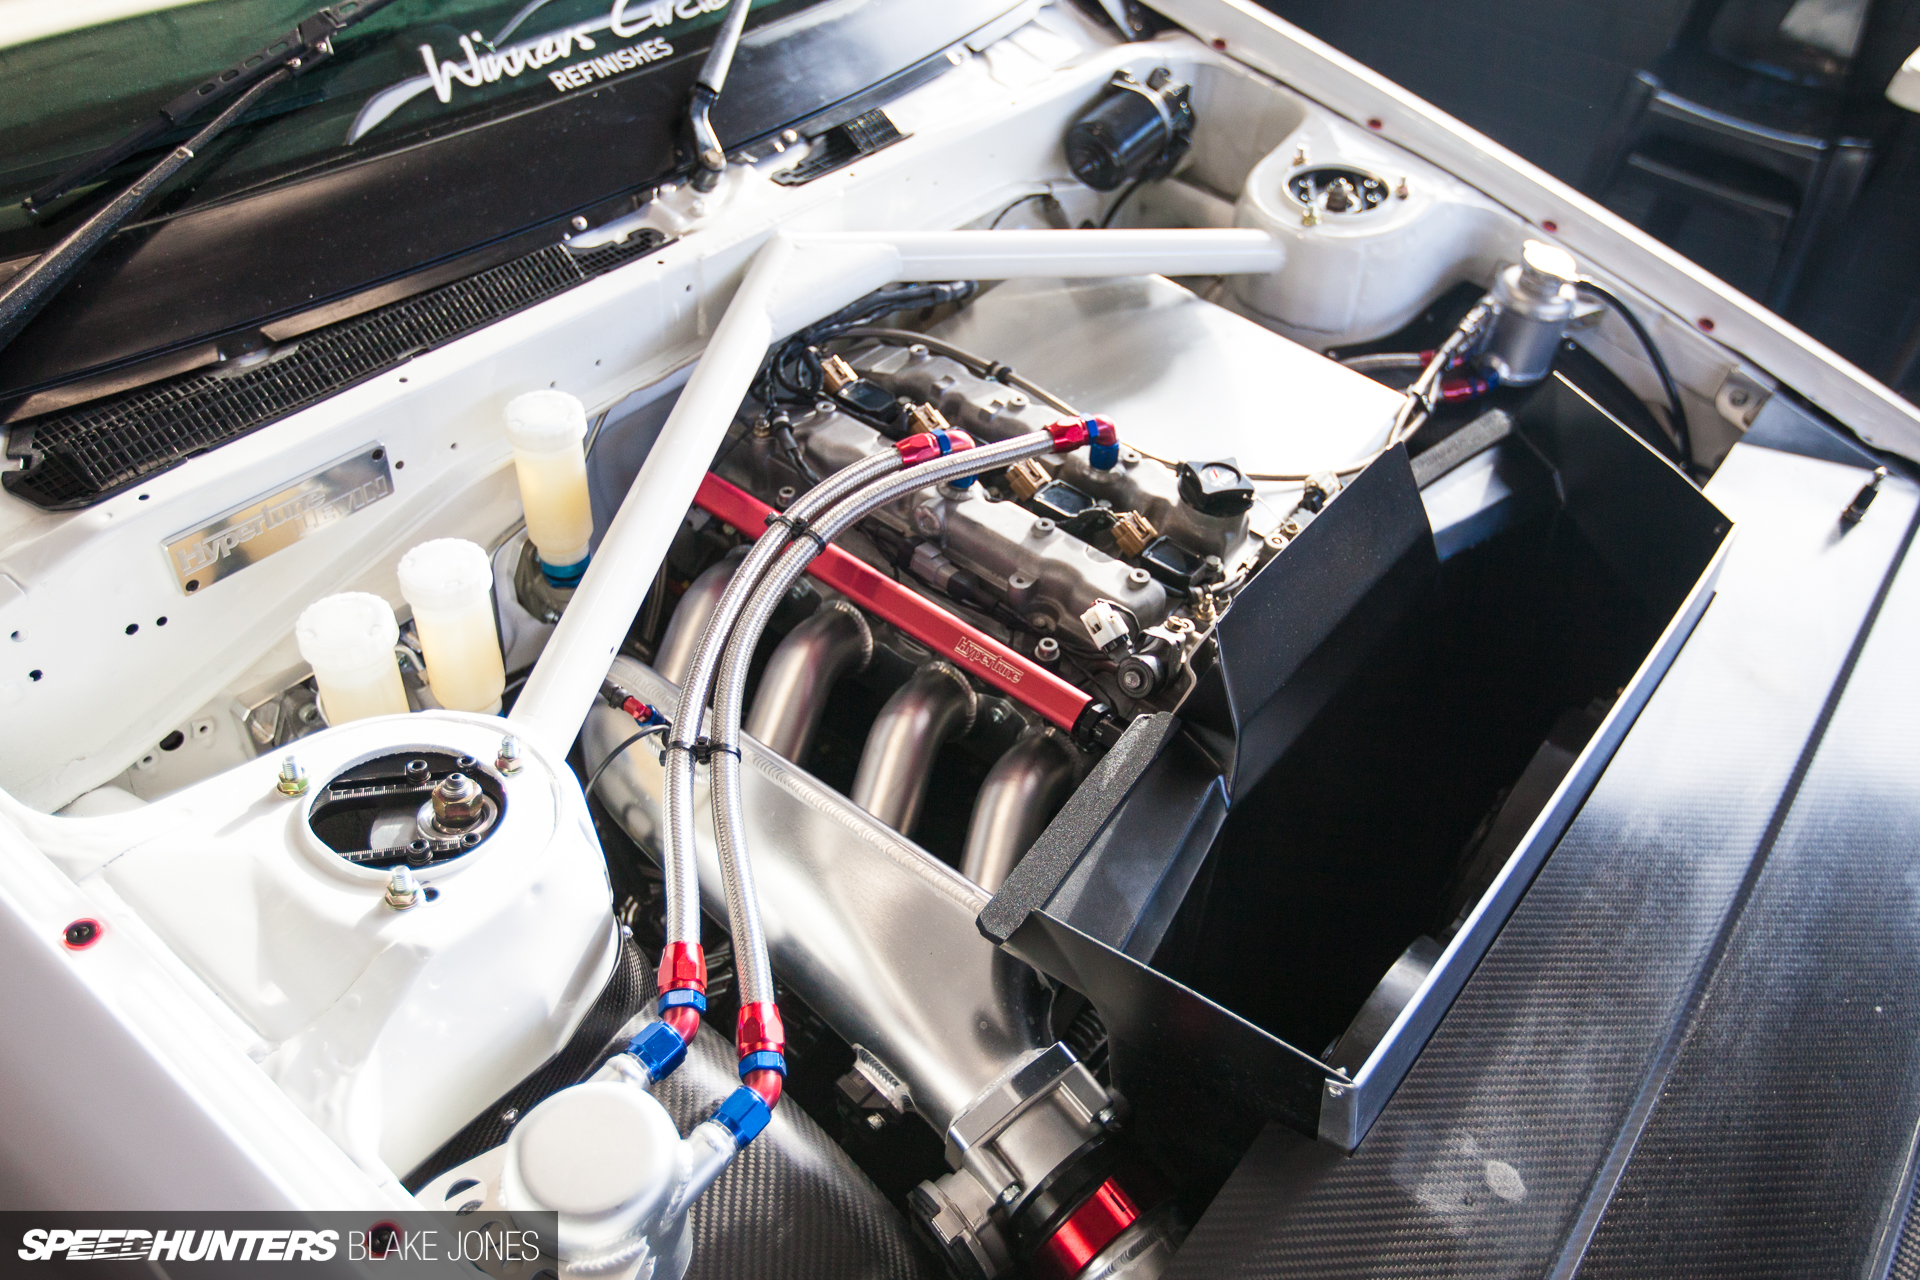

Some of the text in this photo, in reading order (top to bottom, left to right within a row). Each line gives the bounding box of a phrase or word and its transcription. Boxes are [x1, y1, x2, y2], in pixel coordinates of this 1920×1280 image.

[419, 25, 597, 103] Winners
[549, 37, 674, 91] REFINISHES
[176, 484, 326, 577] Hypertune
[296, 474, 388, 538] LEVIN
[954, 636, 1024, 683] Hypertune
